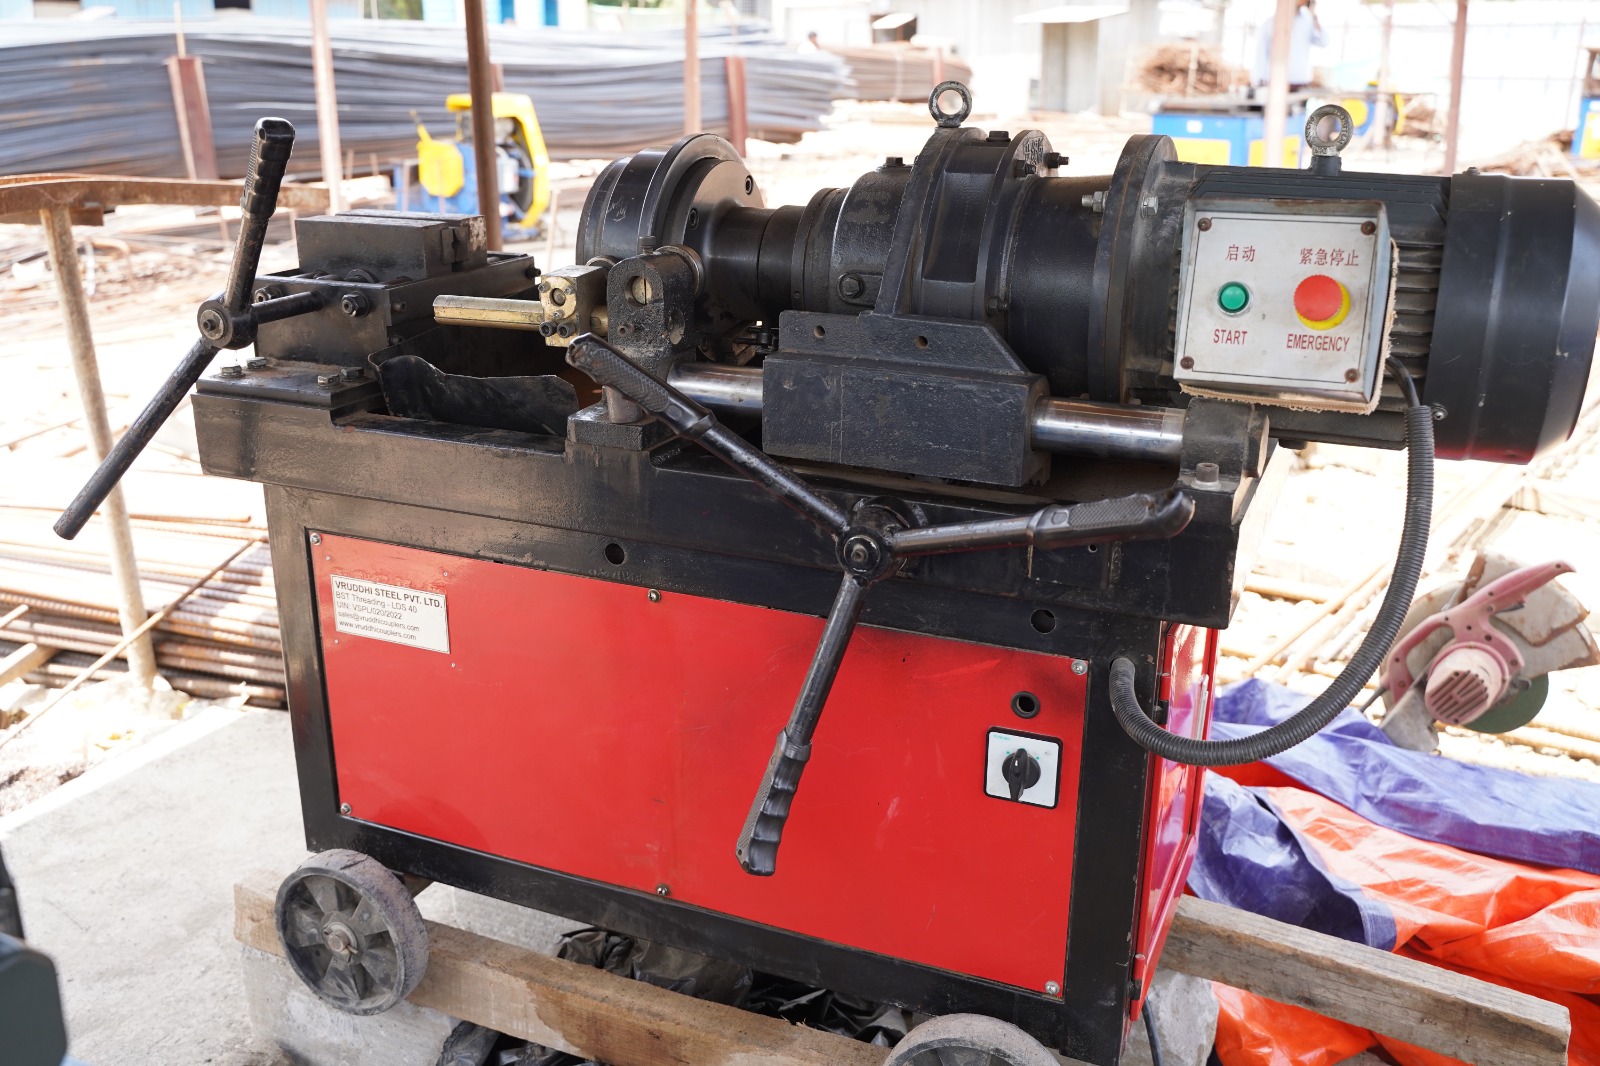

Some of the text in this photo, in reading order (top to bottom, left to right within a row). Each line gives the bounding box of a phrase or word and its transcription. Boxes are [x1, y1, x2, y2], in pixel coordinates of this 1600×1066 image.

[1225, 243, 1256, 262] 启动
[1299, 247, 1359, 267] 紧急停止
[1213, 328, 1248, 345] START
[1286, 333, 1351, 352] EMERGENCY
[334, 580, 443, 609] VRUDDHI STEEL PVT. LTD.
[335, 590, 349, 600] BST
[352, 593, 386, 609] Threading
[391, 602, 407, 612] LDS
[408, 604, 418, 614] 40
[336, 600, 350, 610] UIN:
